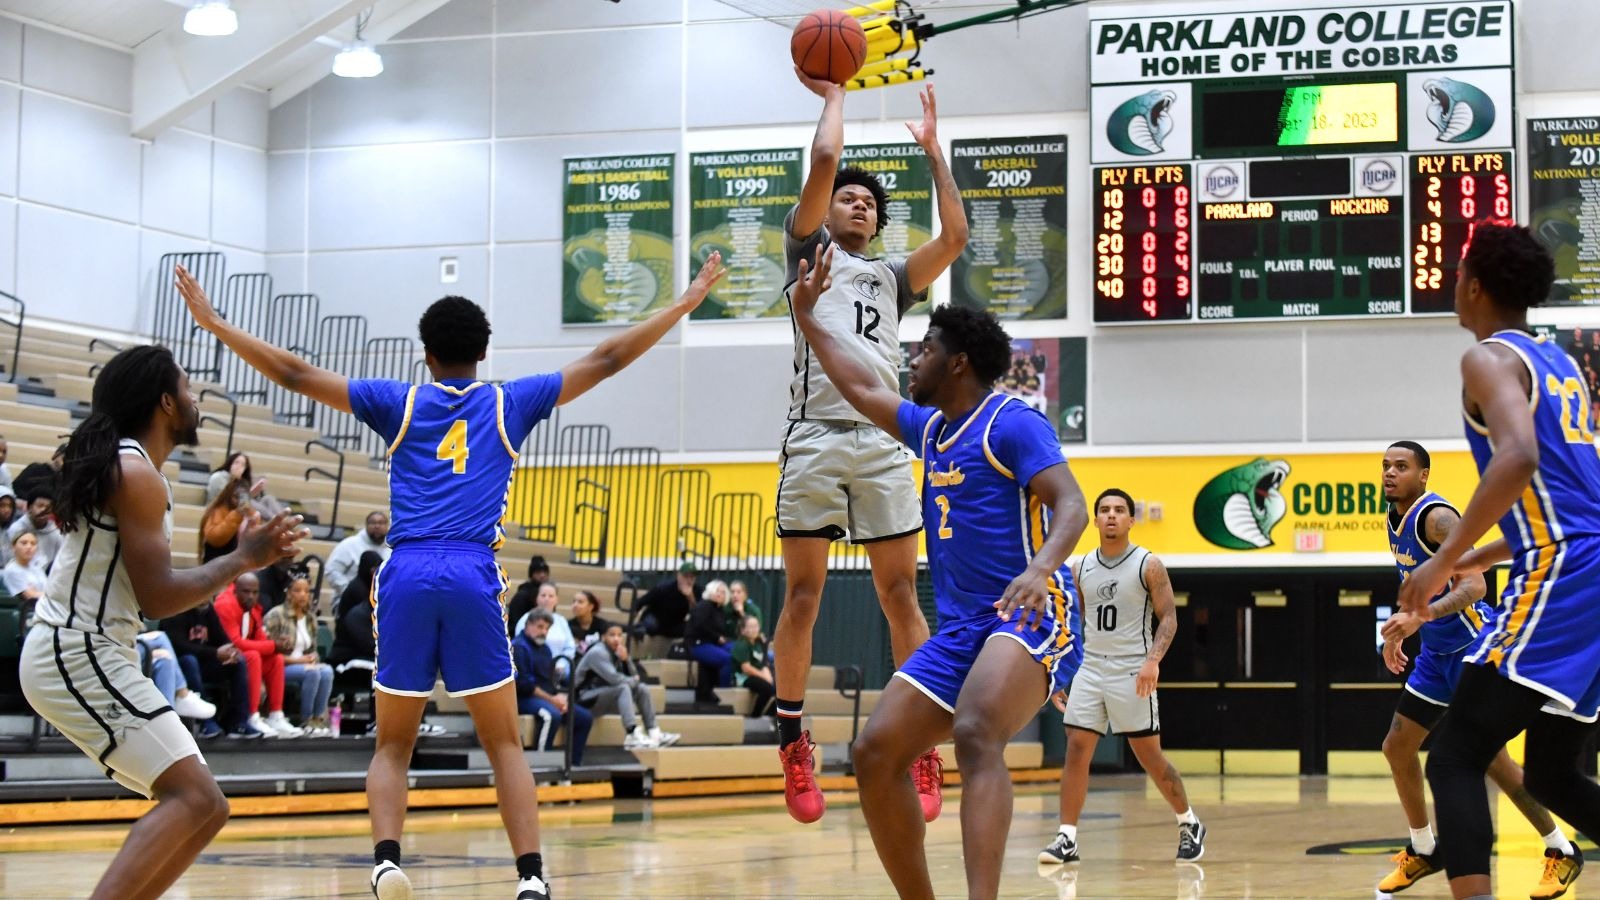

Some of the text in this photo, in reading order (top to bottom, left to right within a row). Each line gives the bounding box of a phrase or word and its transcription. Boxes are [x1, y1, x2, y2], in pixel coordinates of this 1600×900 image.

[1096, 5, 1505, 55] PARKLAND COLLEGE
[1141, 44, 1458, 77] HOME OF THE COBRAS
[1343, 112, 1378, 129] 2023
[1533, 119, 1598, 132] PARKLAND
[693, 151, 799, 166] PARKLAND COLLEGE
[881, 146, 926, 157] COLLEG
[954, 143, 1064, 157] PARKLAND COLLEGE
[568, 157, 671, 172] PARKLAND COLLEGE
[716, 166, 786, 178] VOLLEYBALL
[982, 158, 1038, 170] BASEBALL
[1418, 154, 1503, 174] PLY FL PTS
[605, 170, 669, 183] BASKETBALL
[876, 172, 898, 190] 02
[986, 170, 1032, 188] 2009
[1101, 166, 1183, 185] PLY FL PTS
[1533, 168, 1588, 180] NATIONAL
[599, 183, 641, 201] 1986
[725, 178, 768, 196] 1999
[960, 186, 1064, 199] ATIONAL CHAMPIONS
[1427, 174, 1508, 198] 2 0 5
[694, 198, 740, 209] NATIONAL
[1103, 186, 1188, 209] 10 0 0
[567, 200, 671, 214] NATIONAL CHAMPIONS
[1205, 202, 1273, 220] PARKLAND
[1281, 209, 1318, 222] PERIOD
[1330, 199, 1389, 215] HOCKING
[1427, 197, 1509, 219] 4 0 0
[1103, 207, 1188, 230] 12 1 6
[1421, 222, 1442, 243] 13
[1097, 231, 1189, 254] 20 0 2
[1098, 253, 1189, 275] 30 0 4
[1415, 245, 1442, 265] 21
[1200, 262, 1233, 274] FOULS
[1264, 259, 1304, 272] PLAYER
[1309, 258, 1336, 271] FOUL
[1368, 256, 1402, 269] FOULS
[1097, 275, 1189, 298] 40 0 3
[1415, 268, 1442, 290] 22
[1142, 299, 1156, 318] 4
[1200, 300, 1402, 318] SCORE MATCH SCORE
[853, 300, 881, 344] 12
[1545, 373, 1595, 444] 22
[436, 419, 469, 474] 4
[934, 494, 953, 539] 2
[1294, 520, 1359, 531] PARKLAND
[1096, 604, 1117, 632] 10
